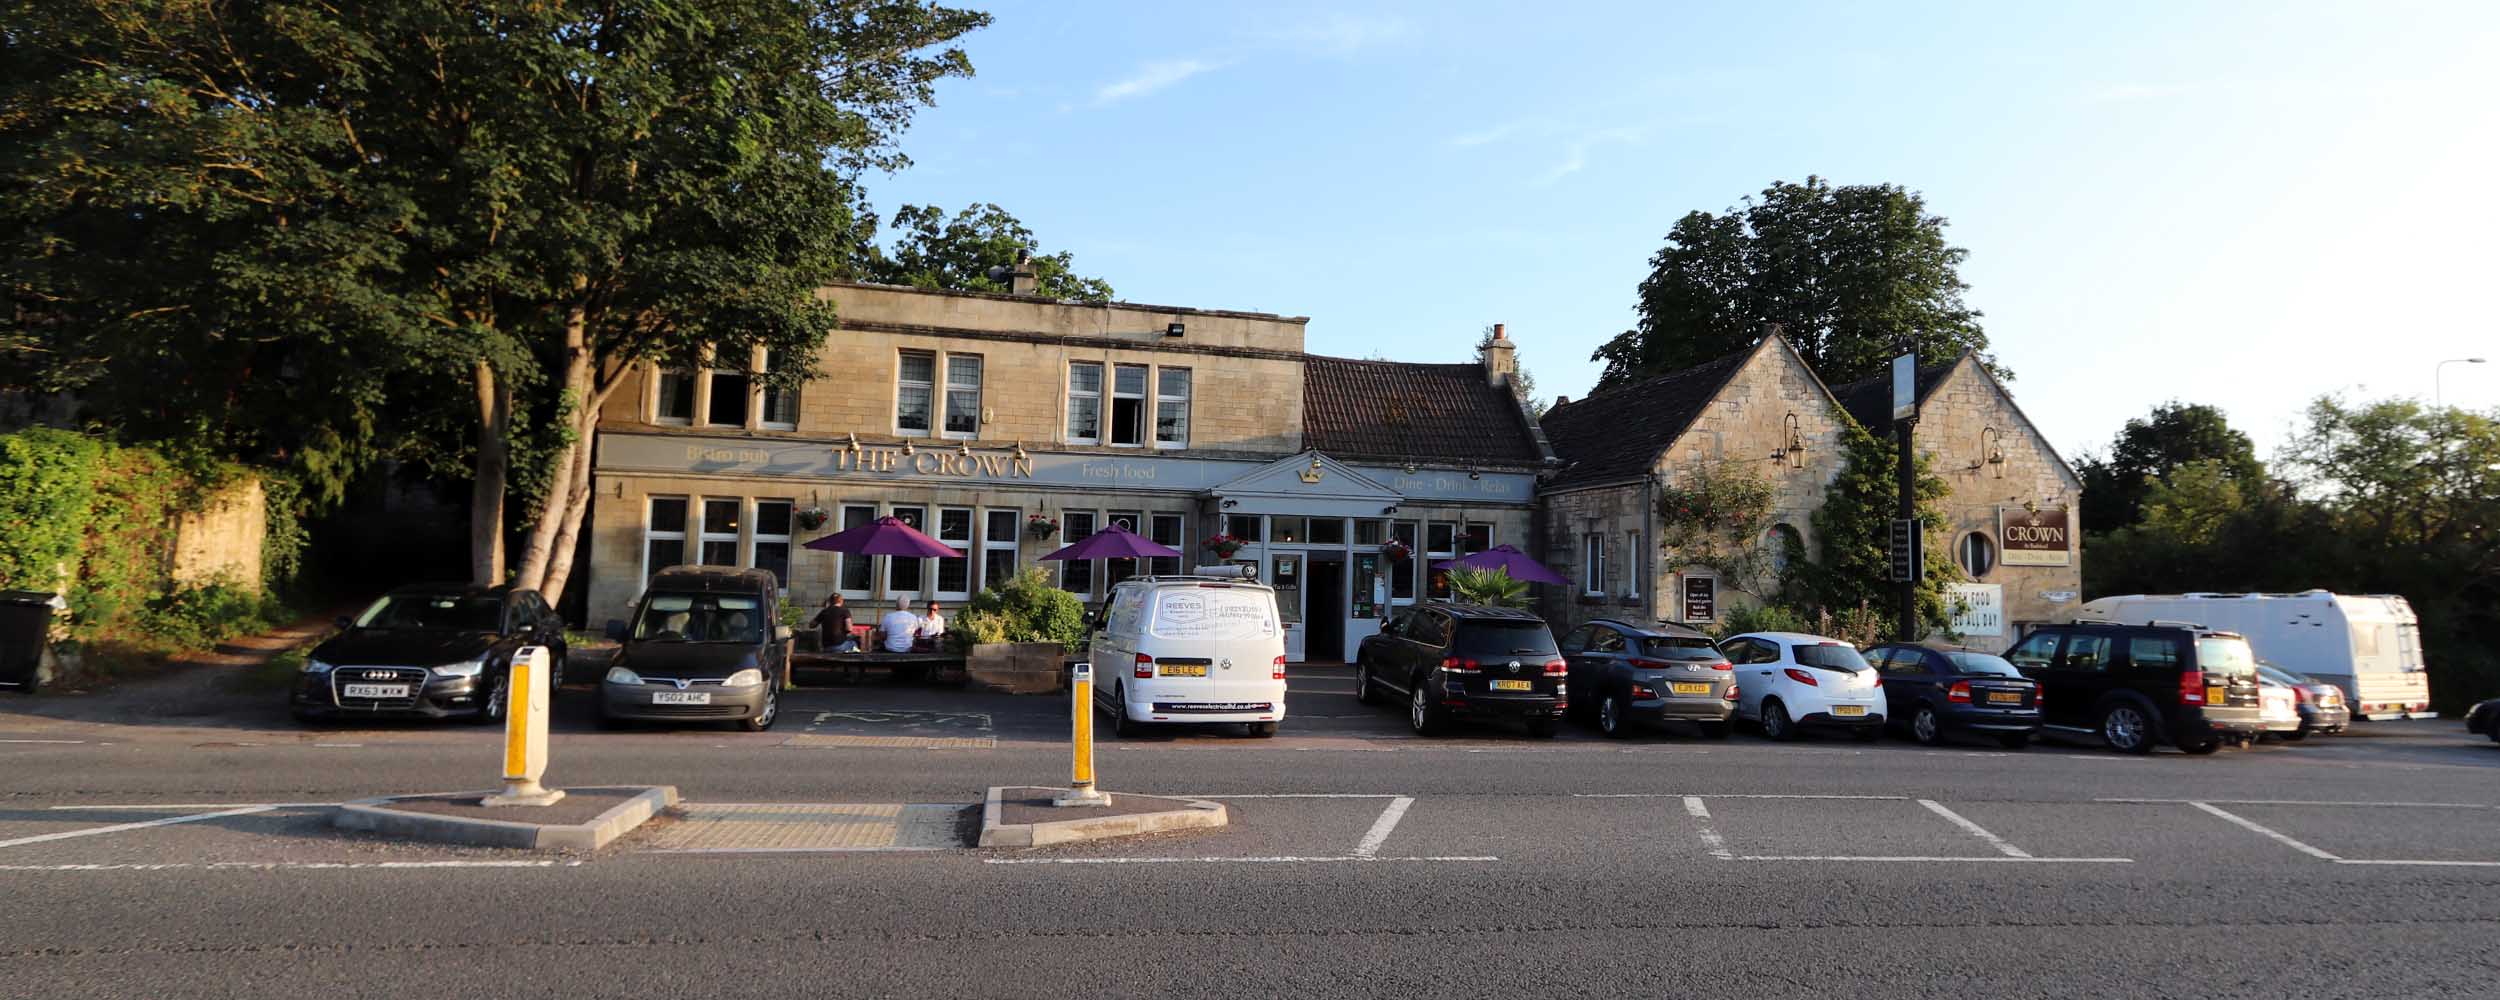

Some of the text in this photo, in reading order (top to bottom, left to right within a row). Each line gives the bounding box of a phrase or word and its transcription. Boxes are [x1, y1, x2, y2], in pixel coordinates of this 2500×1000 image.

[740, 449, 769, 466] pub
[831, 447, 1034, 479] THE CROWN
[1082, 463, 1156, 480] Fresh food
[1393, 476, 1424, 490] Dine
[2007, 526, 2064, 542] CROWN
[1972, 592, 1991, 606] FOOD
[1967, 614, 1980, 627] ALL
[1983, 614, 1997, 627] DAY
